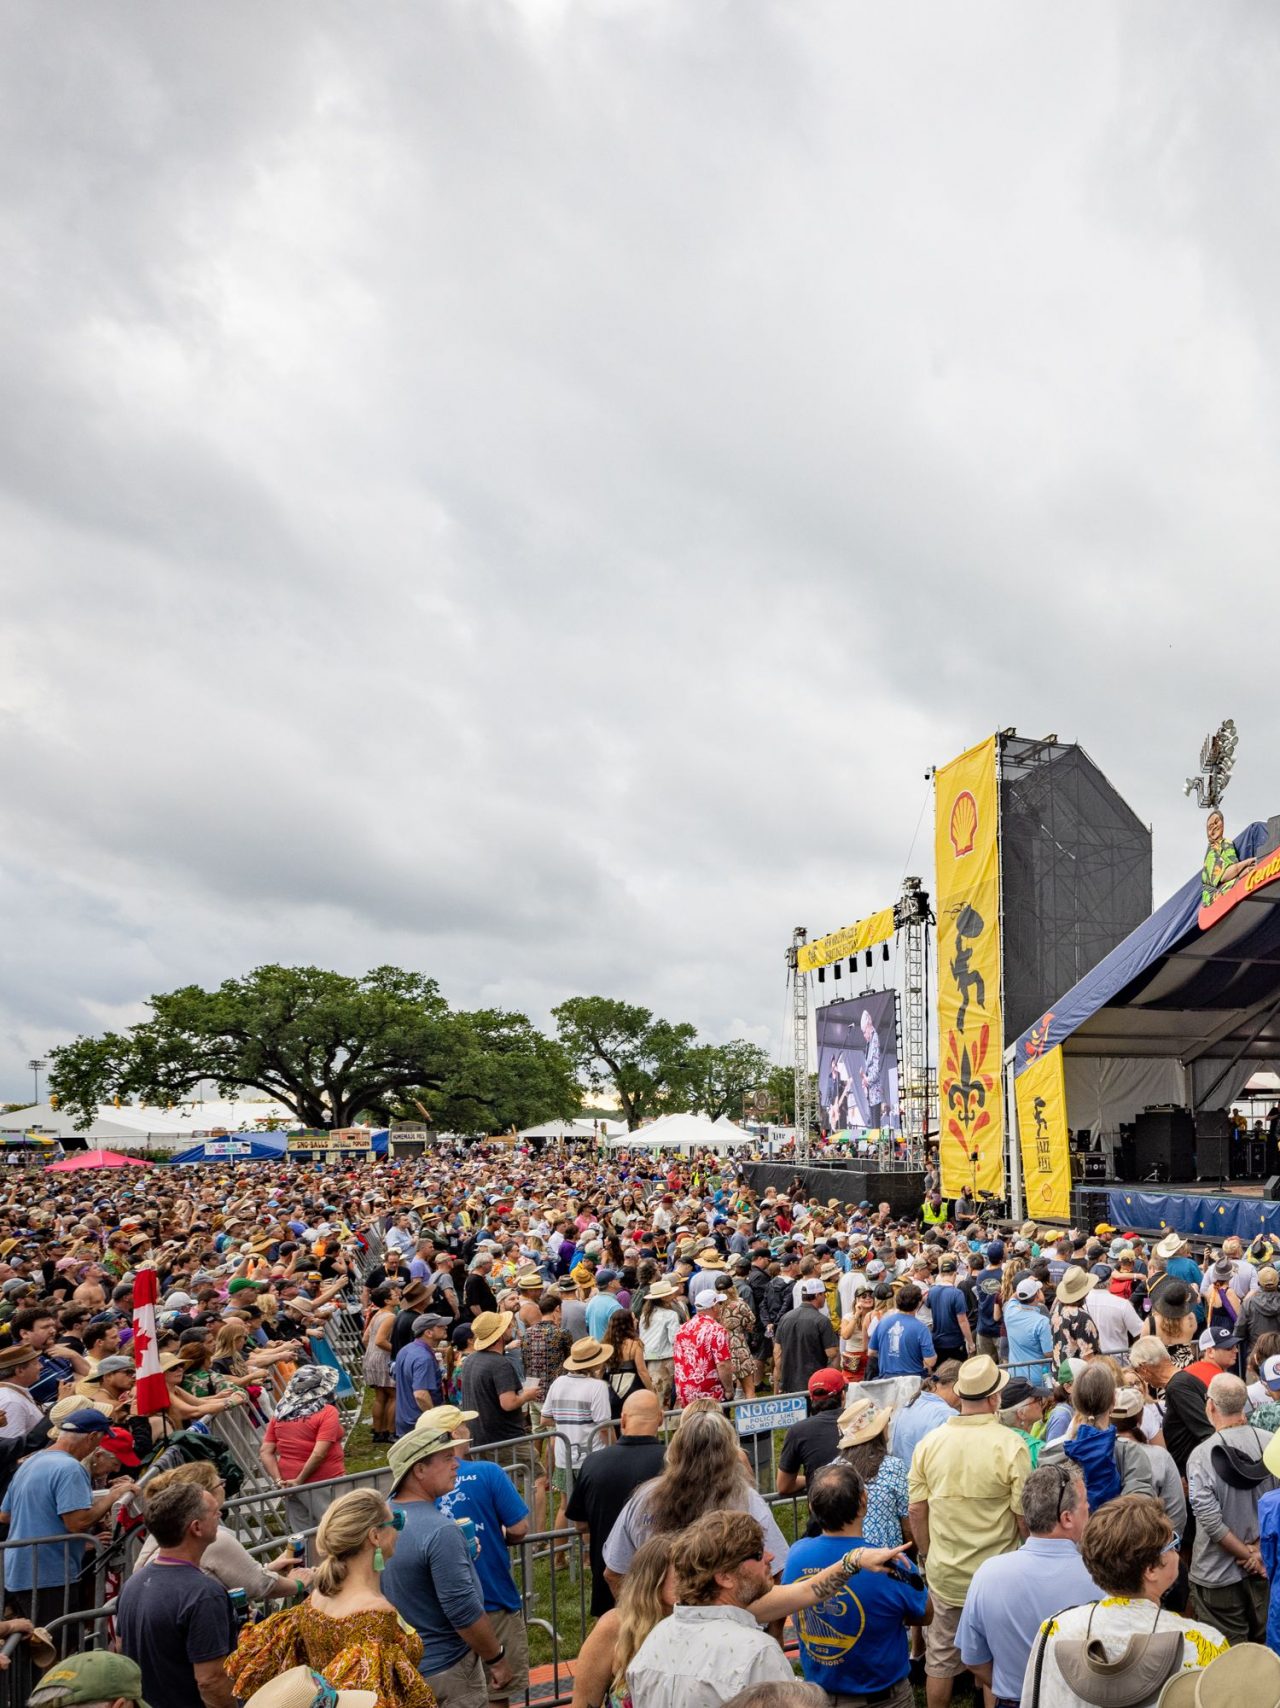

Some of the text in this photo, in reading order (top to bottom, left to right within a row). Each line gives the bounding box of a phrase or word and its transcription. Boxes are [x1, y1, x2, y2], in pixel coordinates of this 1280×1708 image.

[750, 1412, 795, 1424] POLICE LINE
[455, 1474, 477, 1483] ULAS
